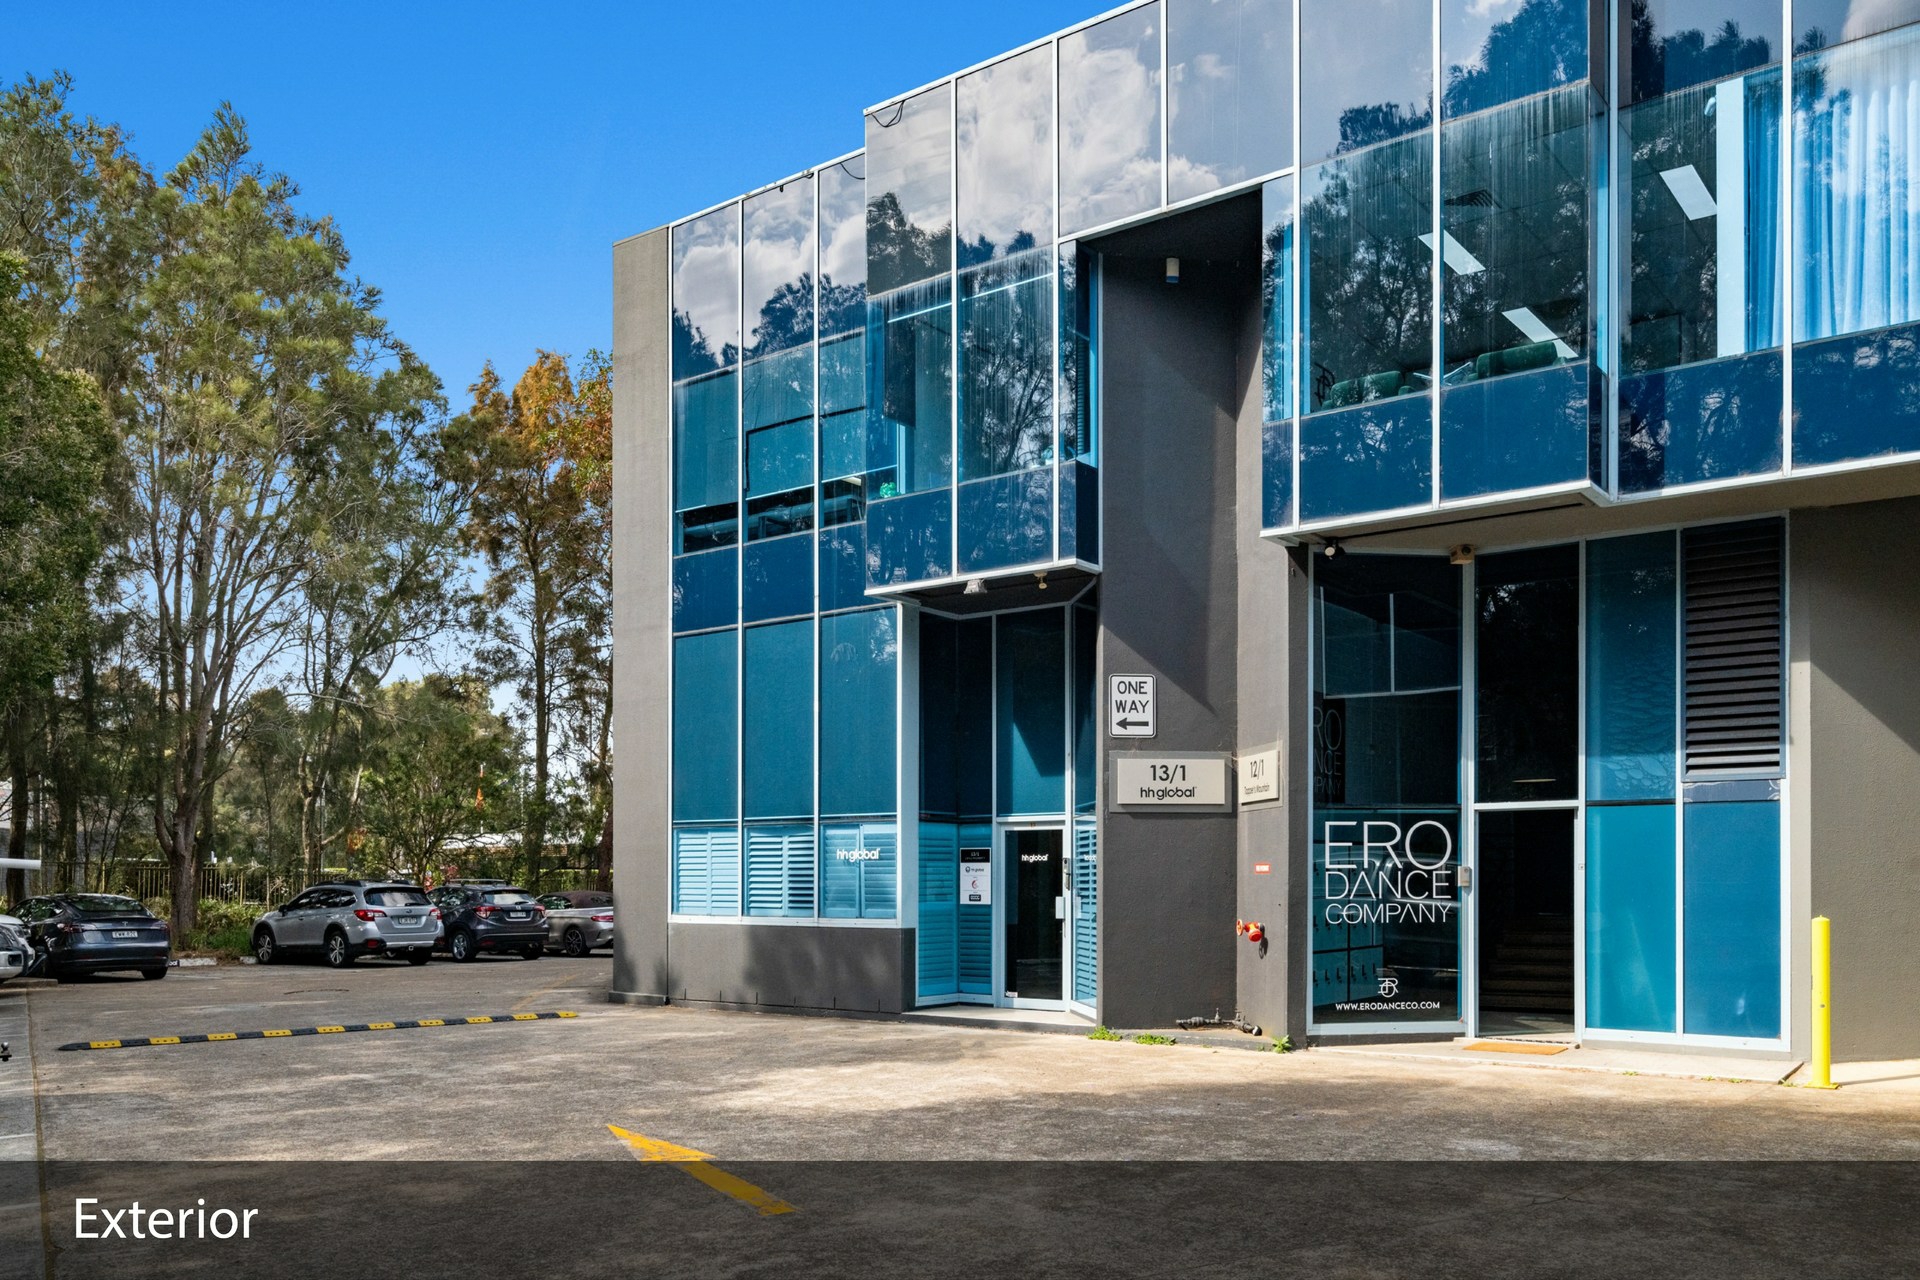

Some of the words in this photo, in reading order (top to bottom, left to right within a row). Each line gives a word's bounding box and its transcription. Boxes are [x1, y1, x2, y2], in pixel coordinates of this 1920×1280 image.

[1117, 681, 1148, 695] ONE
[1115, 699, 1150, 713] WAY
[1150, 764, 1186, 784] 13/1
[1250, 758, 1265, 780] 12/1
[1325, 820, 1452, 870] ERO
[1325, 870, 1452, 900] DANCE
[1325, 903, 1452, 924] COMPANY
[1335, 1001, 1440, 1011] WWW.ERODANCECO.COM
